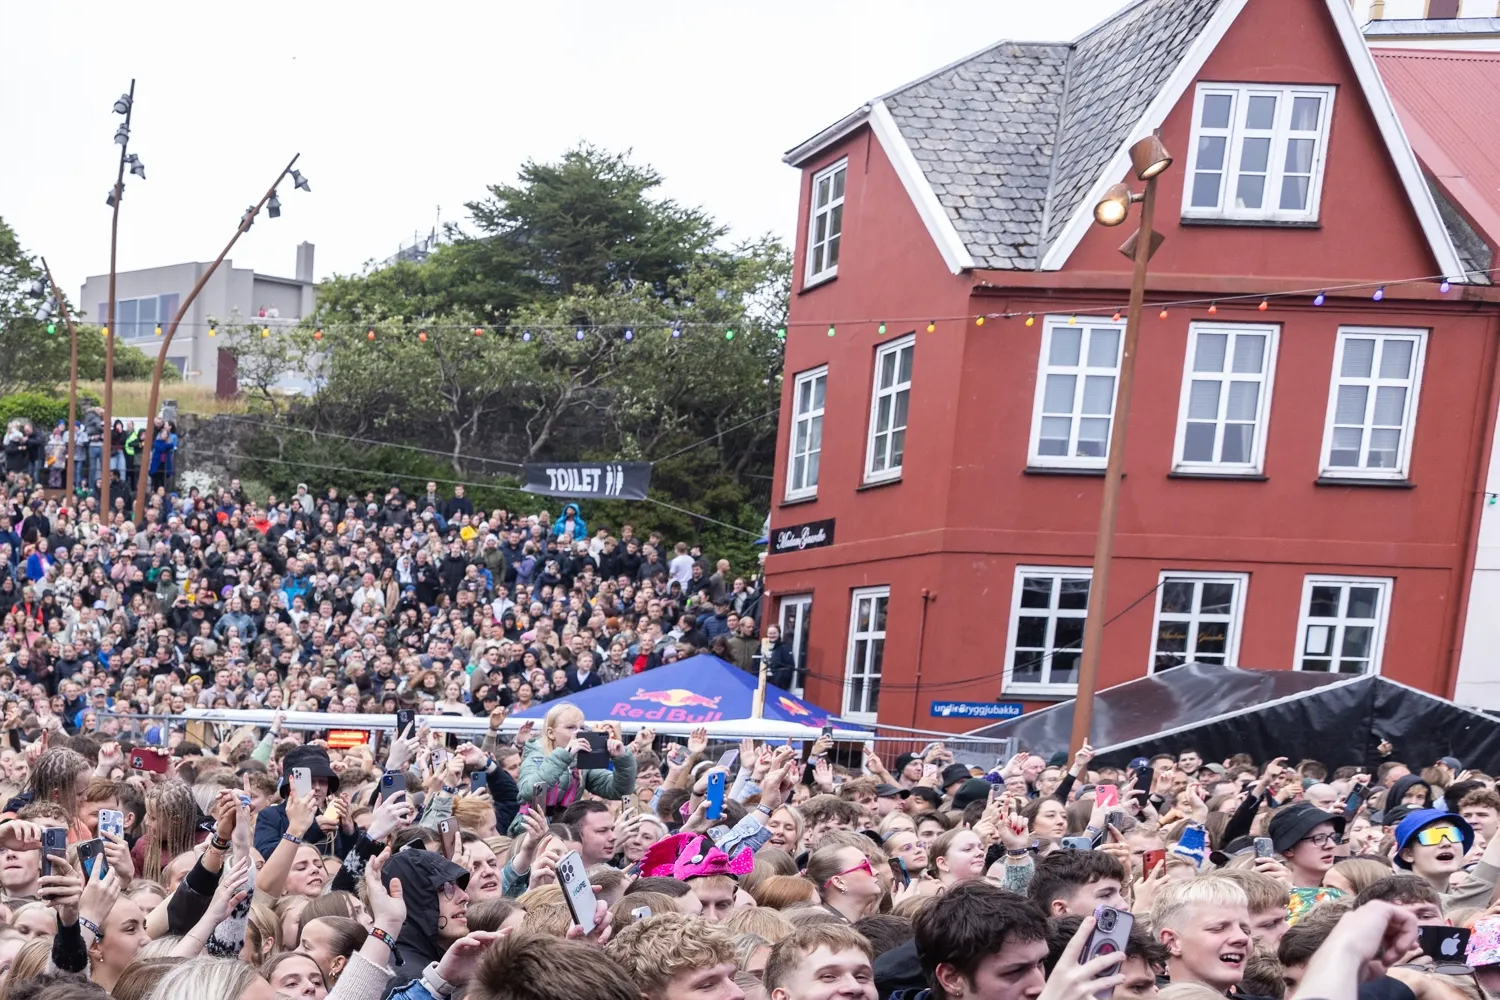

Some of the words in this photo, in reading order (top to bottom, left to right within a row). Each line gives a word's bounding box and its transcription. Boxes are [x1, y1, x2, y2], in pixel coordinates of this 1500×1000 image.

[546, 468, 601, 492] TOILET
[610, 702, 664, 719] Red
[666, 707, 723, 723] Bull
